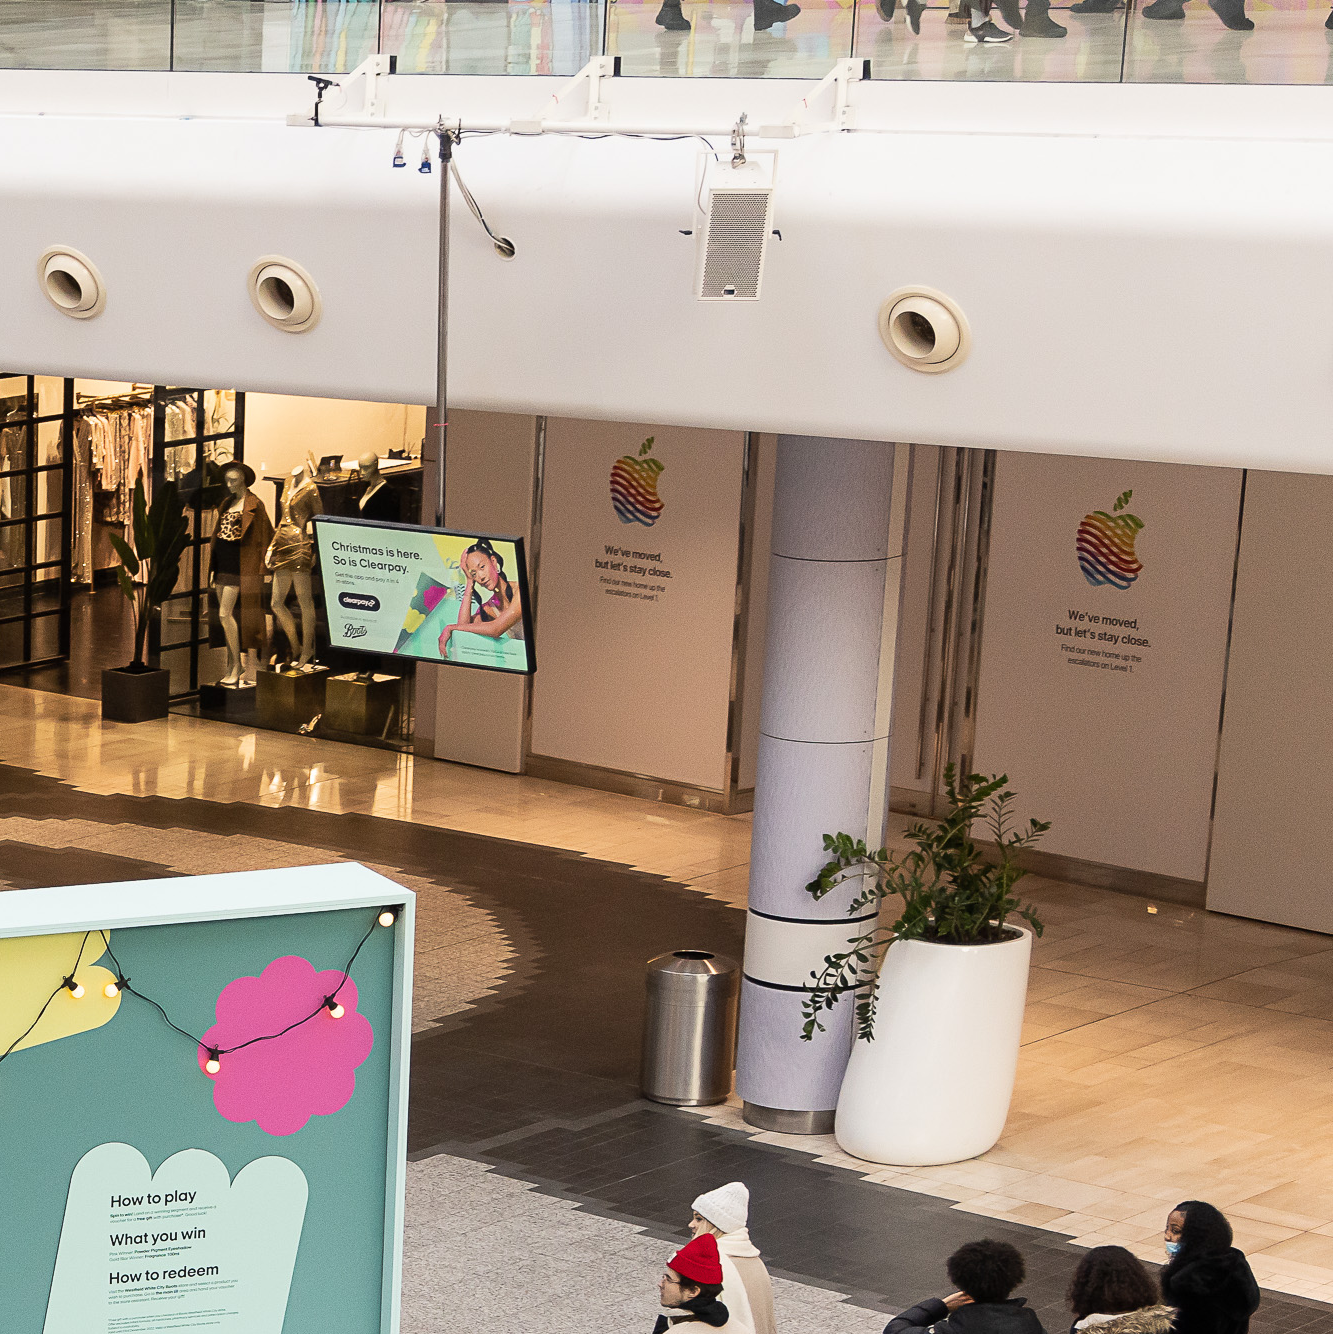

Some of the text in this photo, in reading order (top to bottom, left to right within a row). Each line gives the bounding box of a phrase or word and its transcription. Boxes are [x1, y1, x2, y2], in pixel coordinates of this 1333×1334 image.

[332, 541, 422, 560] Christmas is here.
[605, 545, 663, 563] We've moved,
[333, 556, 409, 574] So is Clearpay.
[595, 559, 609, 569] but
[629, 564, 647, 577] stay
[648, 567, 673, 578] close.
[1068, 609, 1139, 631] We've moved,
[343, 623, 368, 639] Boots
[1056, 624, 1151, 648] but let's stay close.
[111, 1190, 197, 1208] How to play
[110, 1227, 206, 1246] What you win
[109, 1265, 219, 1284] How to redeem
